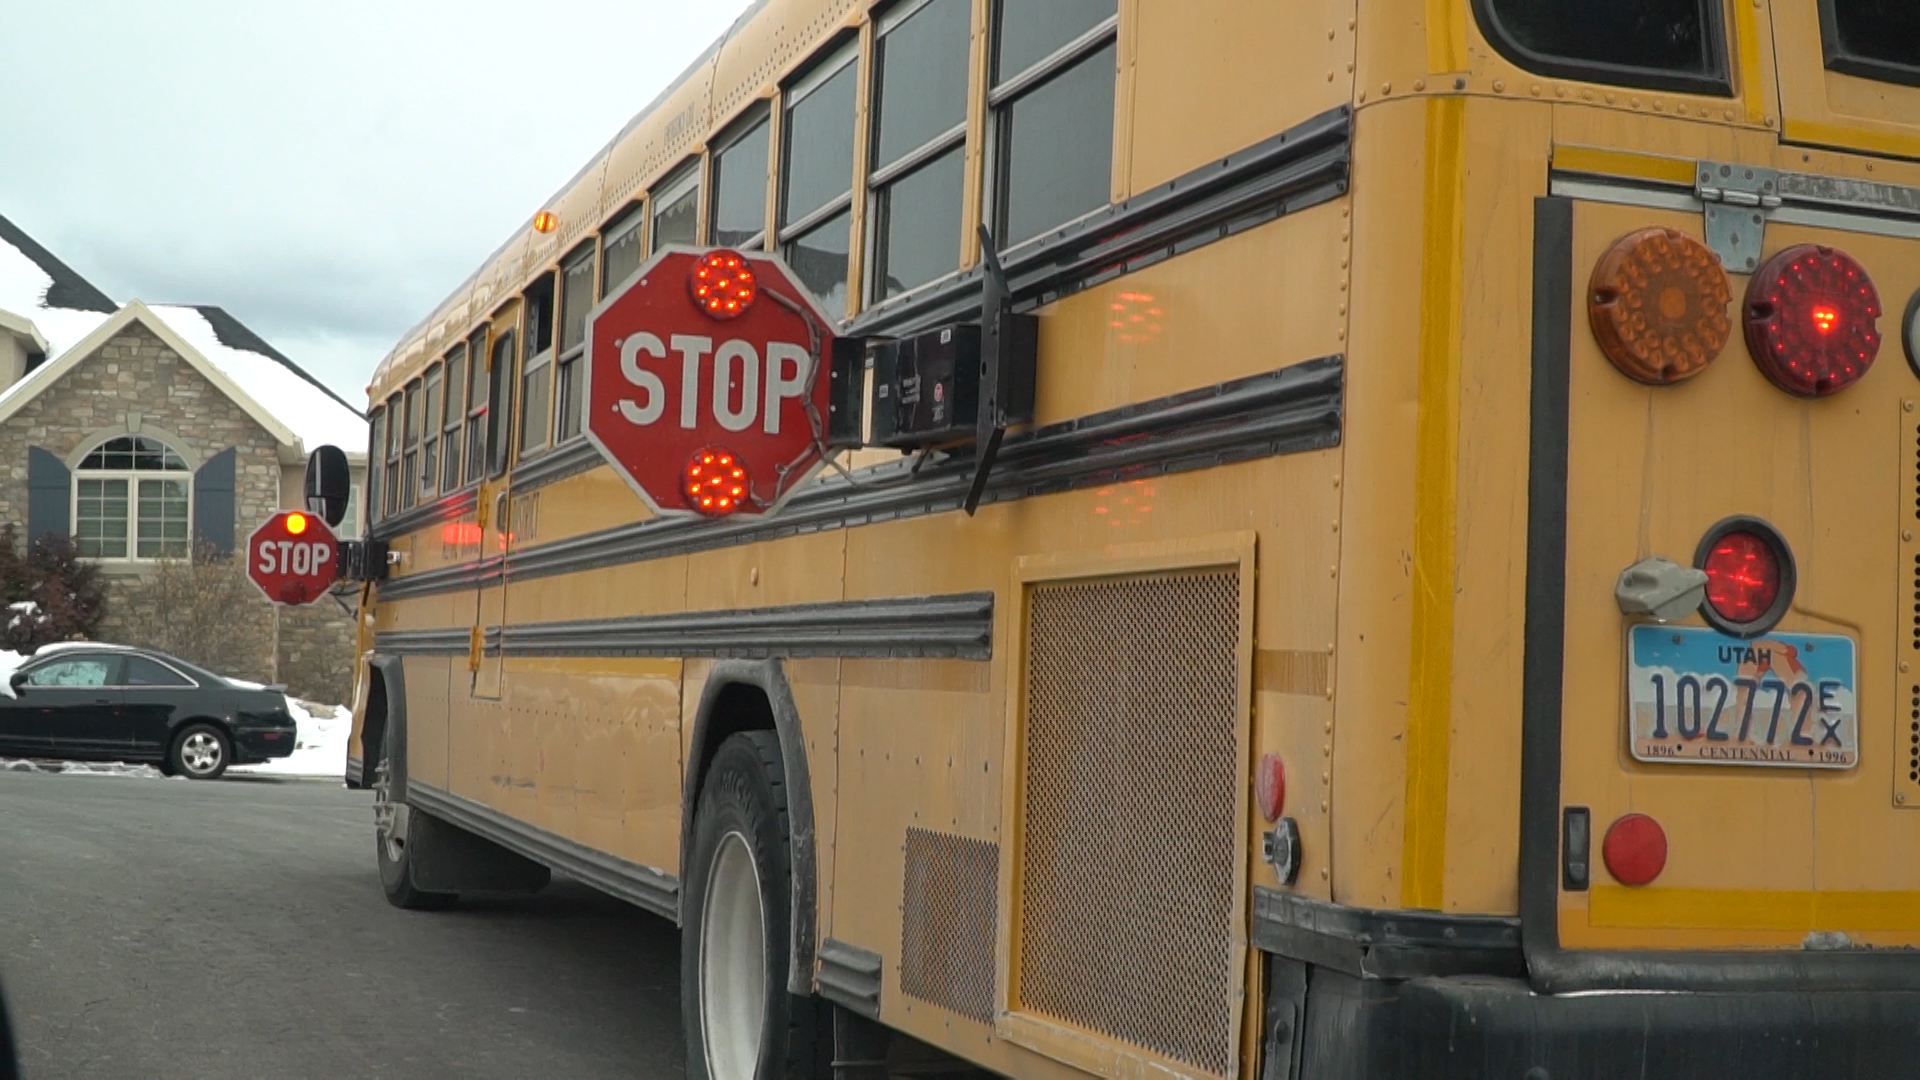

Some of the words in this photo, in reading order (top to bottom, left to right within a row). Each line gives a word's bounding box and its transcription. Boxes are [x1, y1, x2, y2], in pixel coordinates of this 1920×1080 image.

[618, 331, 811, 435] STOP
[258, 541, 331, 577] STOP
[1718, 645, 1771, 666] UTAH
[1651, 673, 1814, 746] 102772
[1646, 745, 1675, 757] 1896
[1699, 746, 1795, 762] CENTENNIAL
[1819, 751, 1847, 764] 1996
